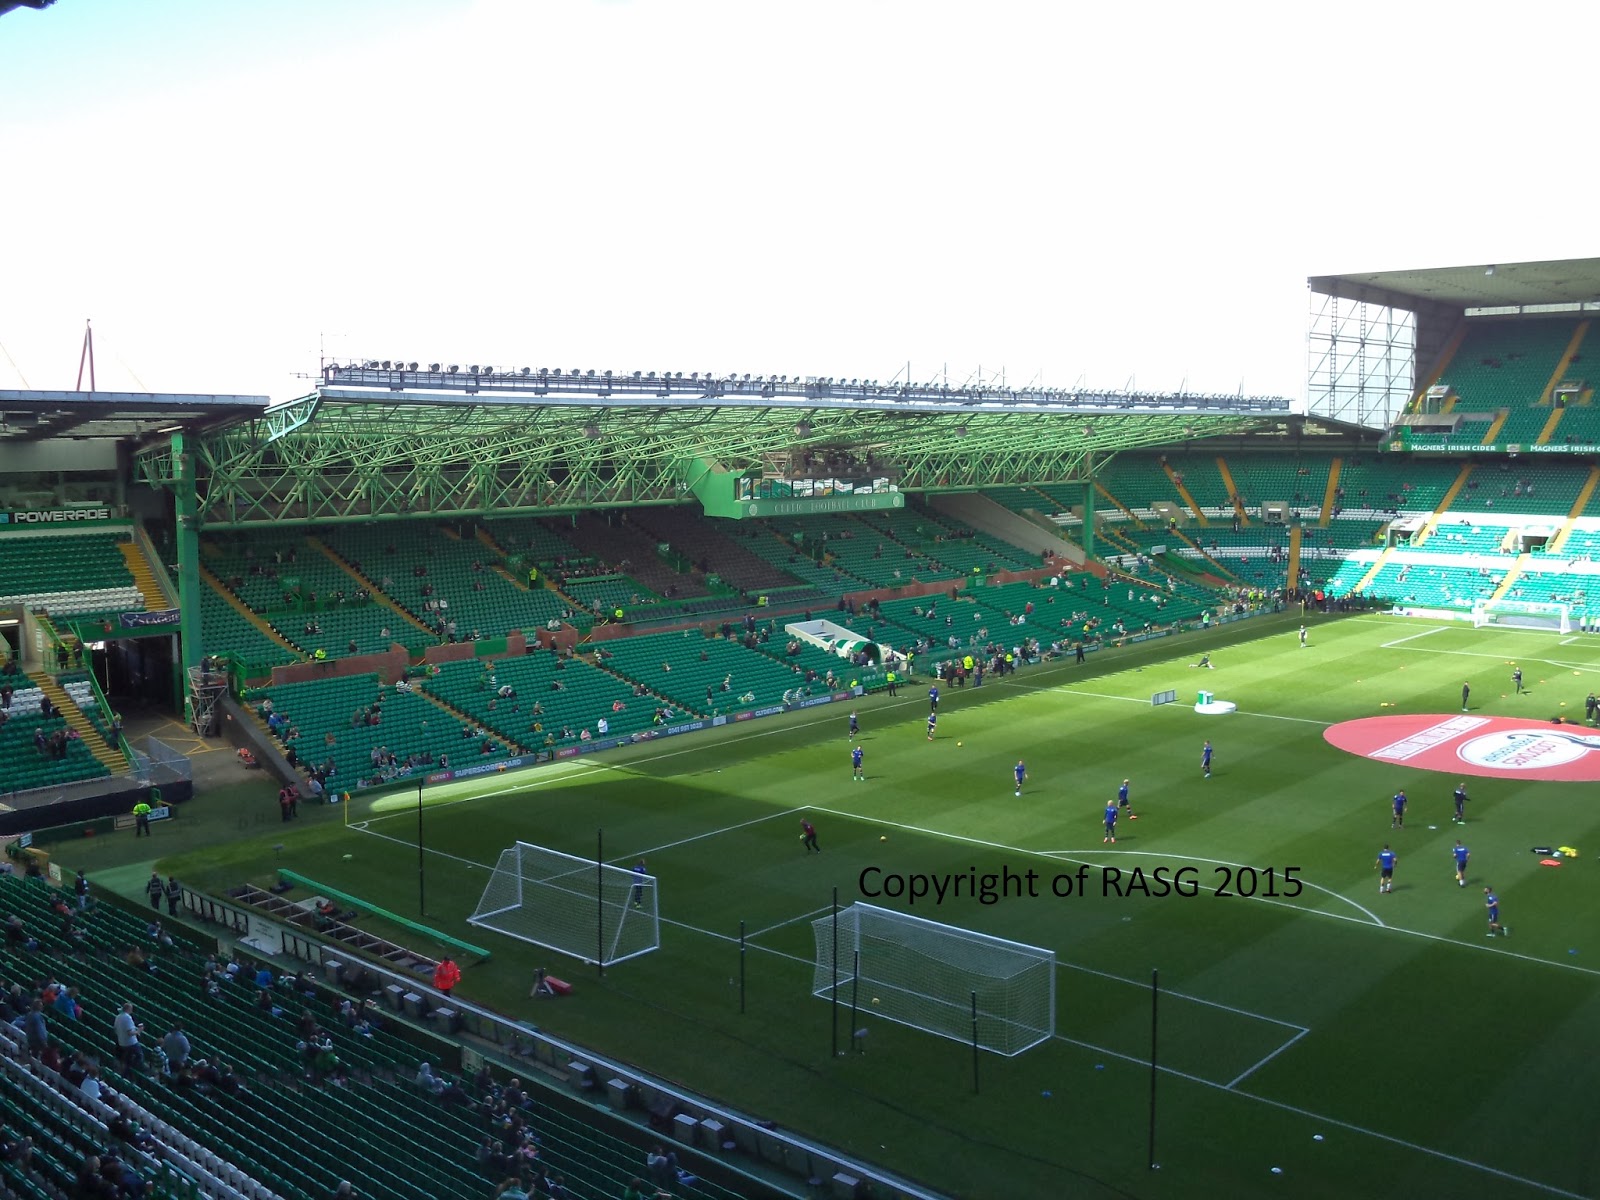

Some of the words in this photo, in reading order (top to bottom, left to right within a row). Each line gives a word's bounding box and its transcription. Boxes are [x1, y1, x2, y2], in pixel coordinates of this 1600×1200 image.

[1530, 444, 1568, 452] MAGNERS
[774, 503, 801, 513] CELTIC
[811, 500, 849, 511] FOOTBALL
[855, 499, 876, 508] CLUB
[14, 509, 108, 523] POWERADE
[455, 759, 522, 777] SUPERSCOREBOARD
